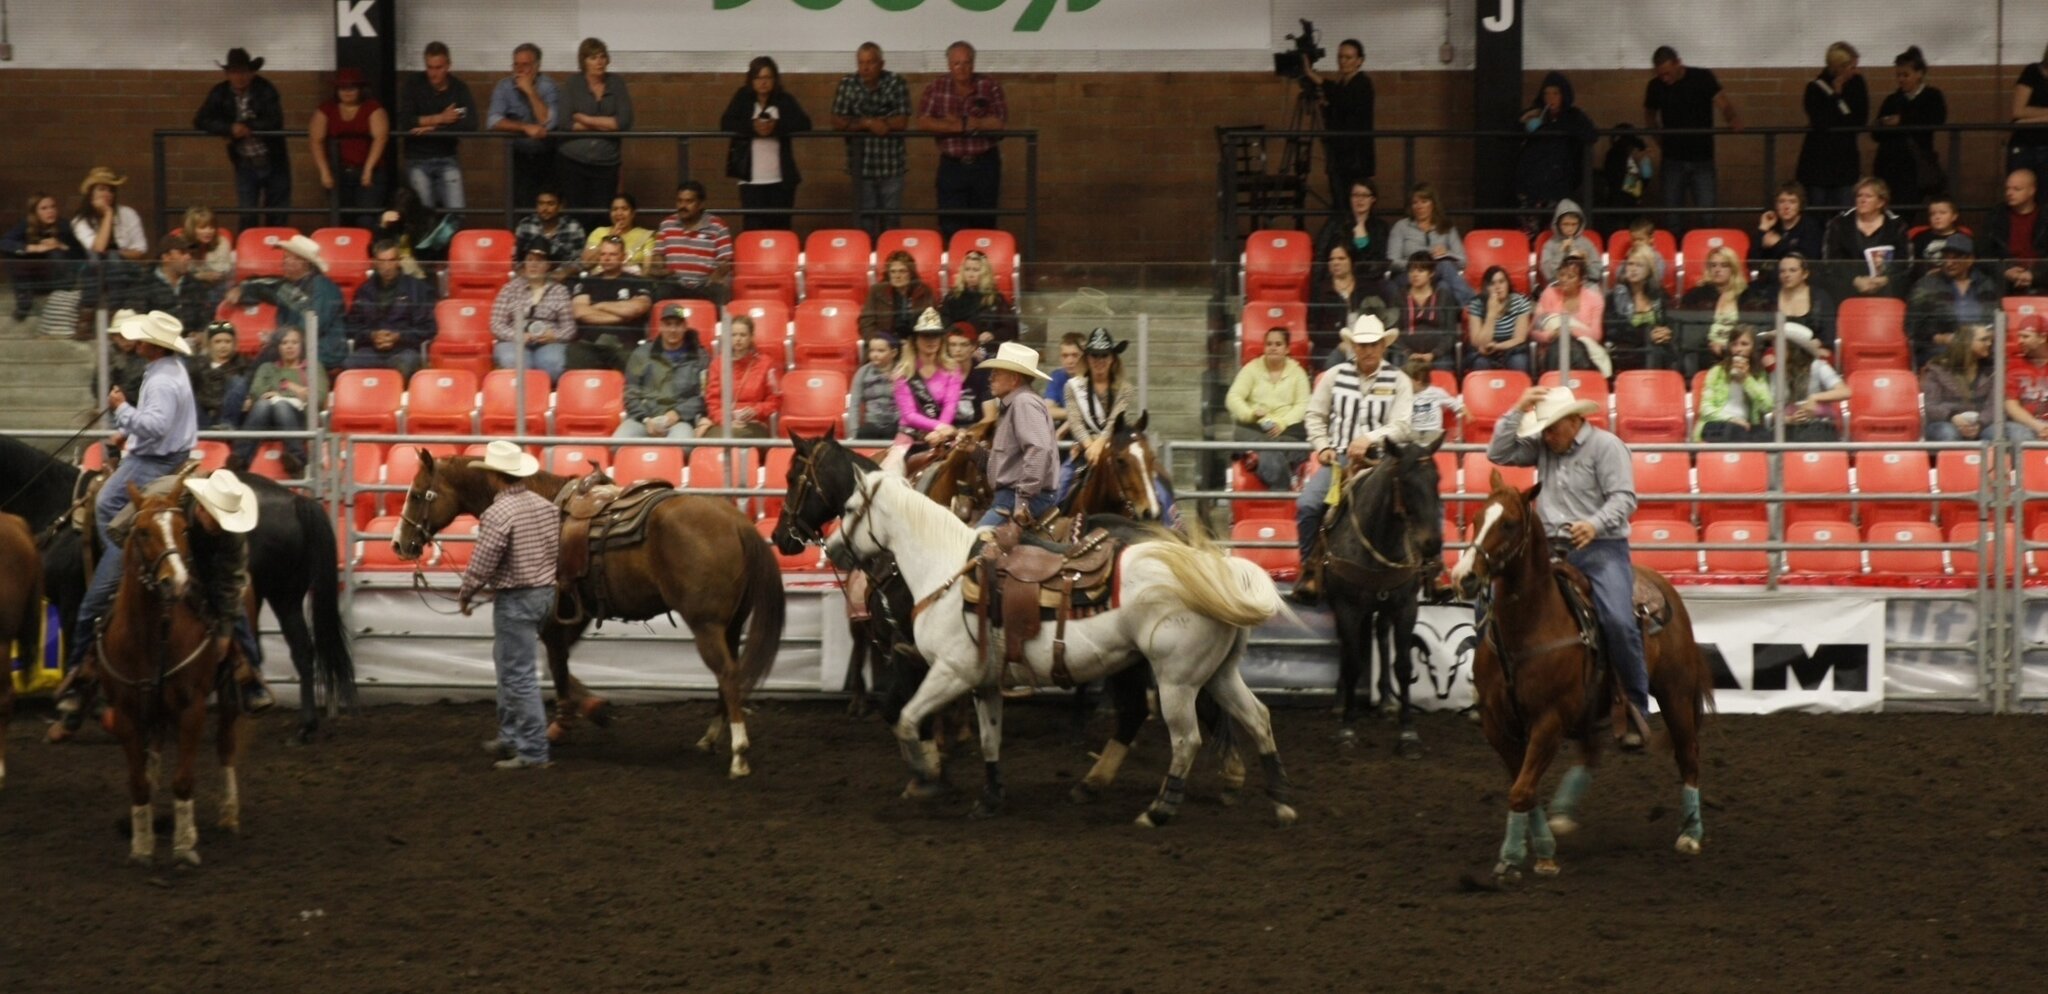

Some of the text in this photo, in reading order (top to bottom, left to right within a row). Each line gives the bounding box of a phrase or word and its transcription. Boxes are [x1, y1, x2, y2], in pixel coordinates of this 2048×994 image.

[337, 0, 378, 37] K
[1482, 0, 1514, 32] J
[1694, 643, 1869, 692] AM
